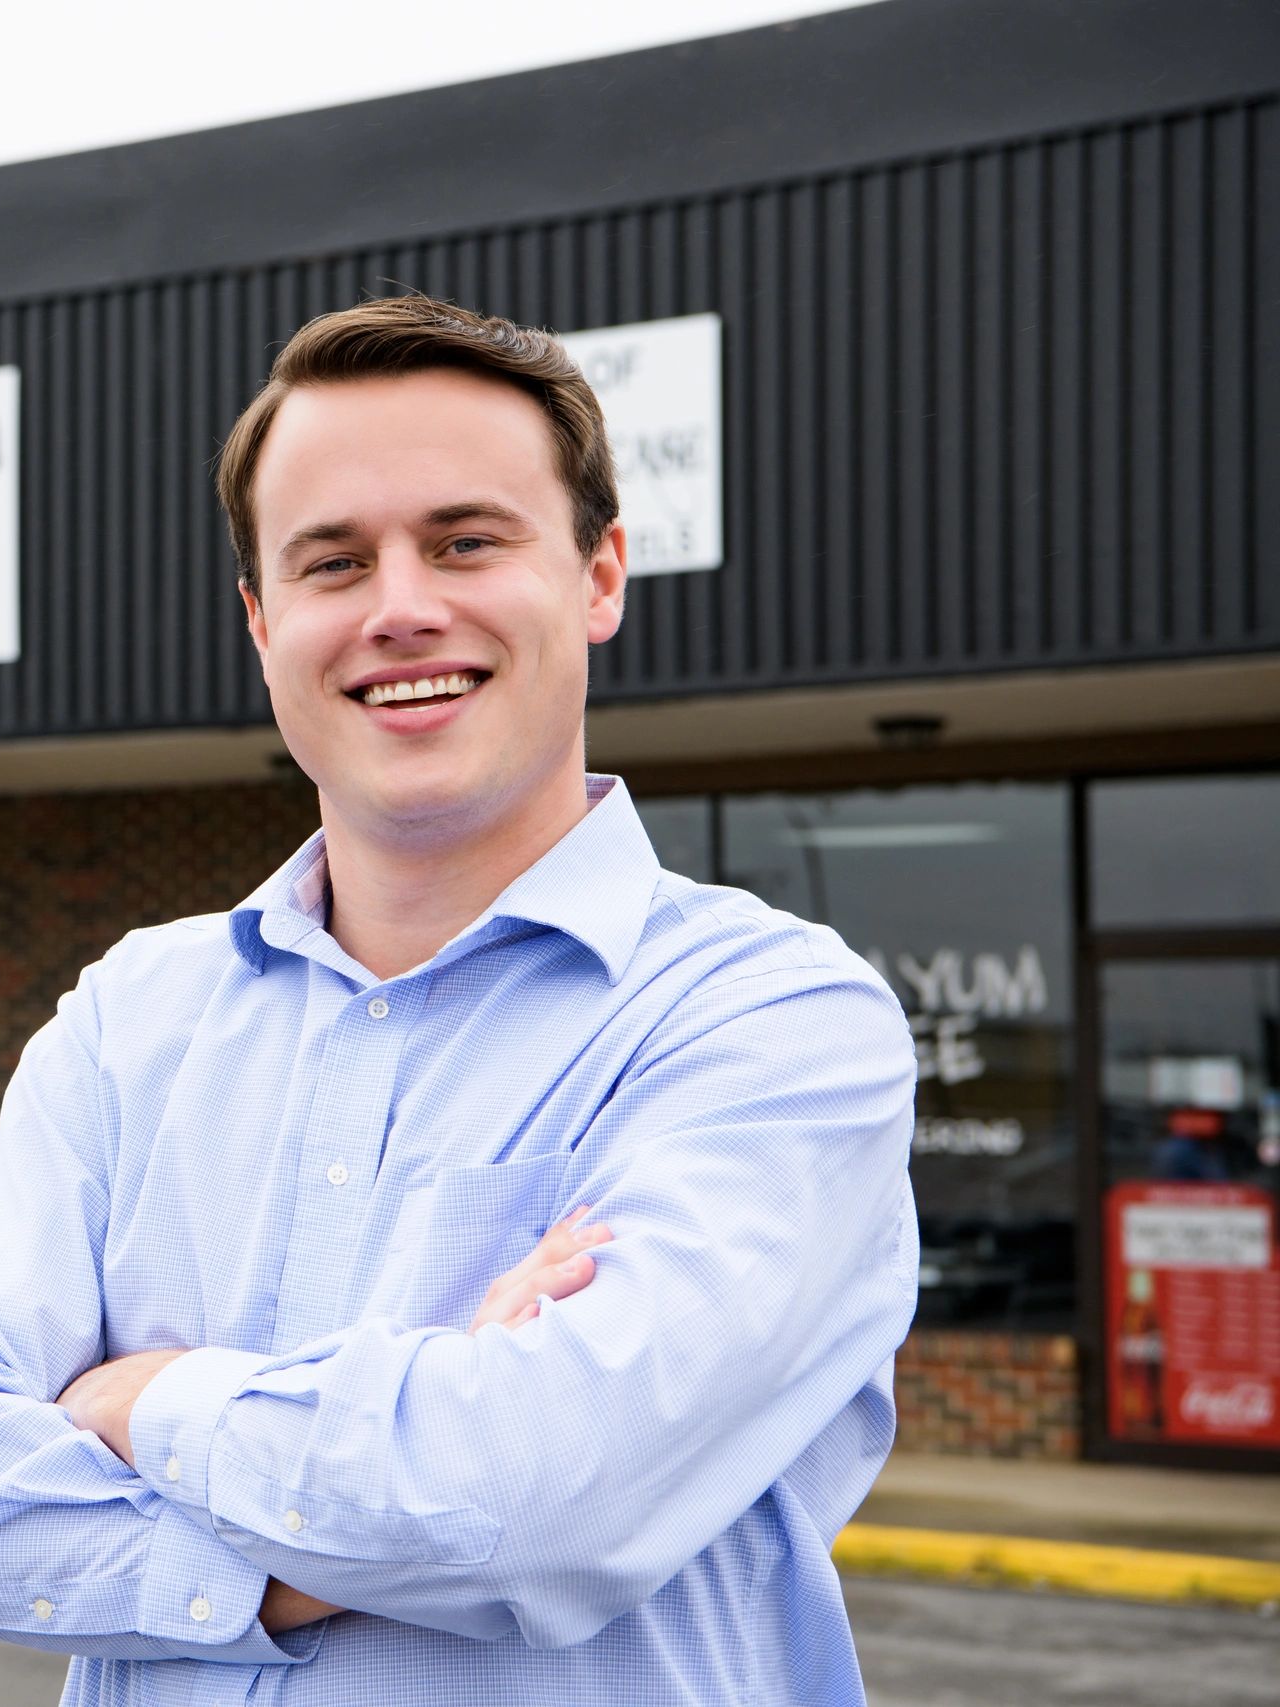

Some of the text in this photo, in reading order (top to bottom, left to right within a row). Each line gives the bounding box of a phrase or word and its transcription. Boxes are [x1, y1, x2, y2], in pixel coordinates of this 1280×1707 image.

[897, 945, 1049, 1019] YUM
[910, 1012, 986, 1085] EE
[912, 1118, 1024, 1156] ERING
